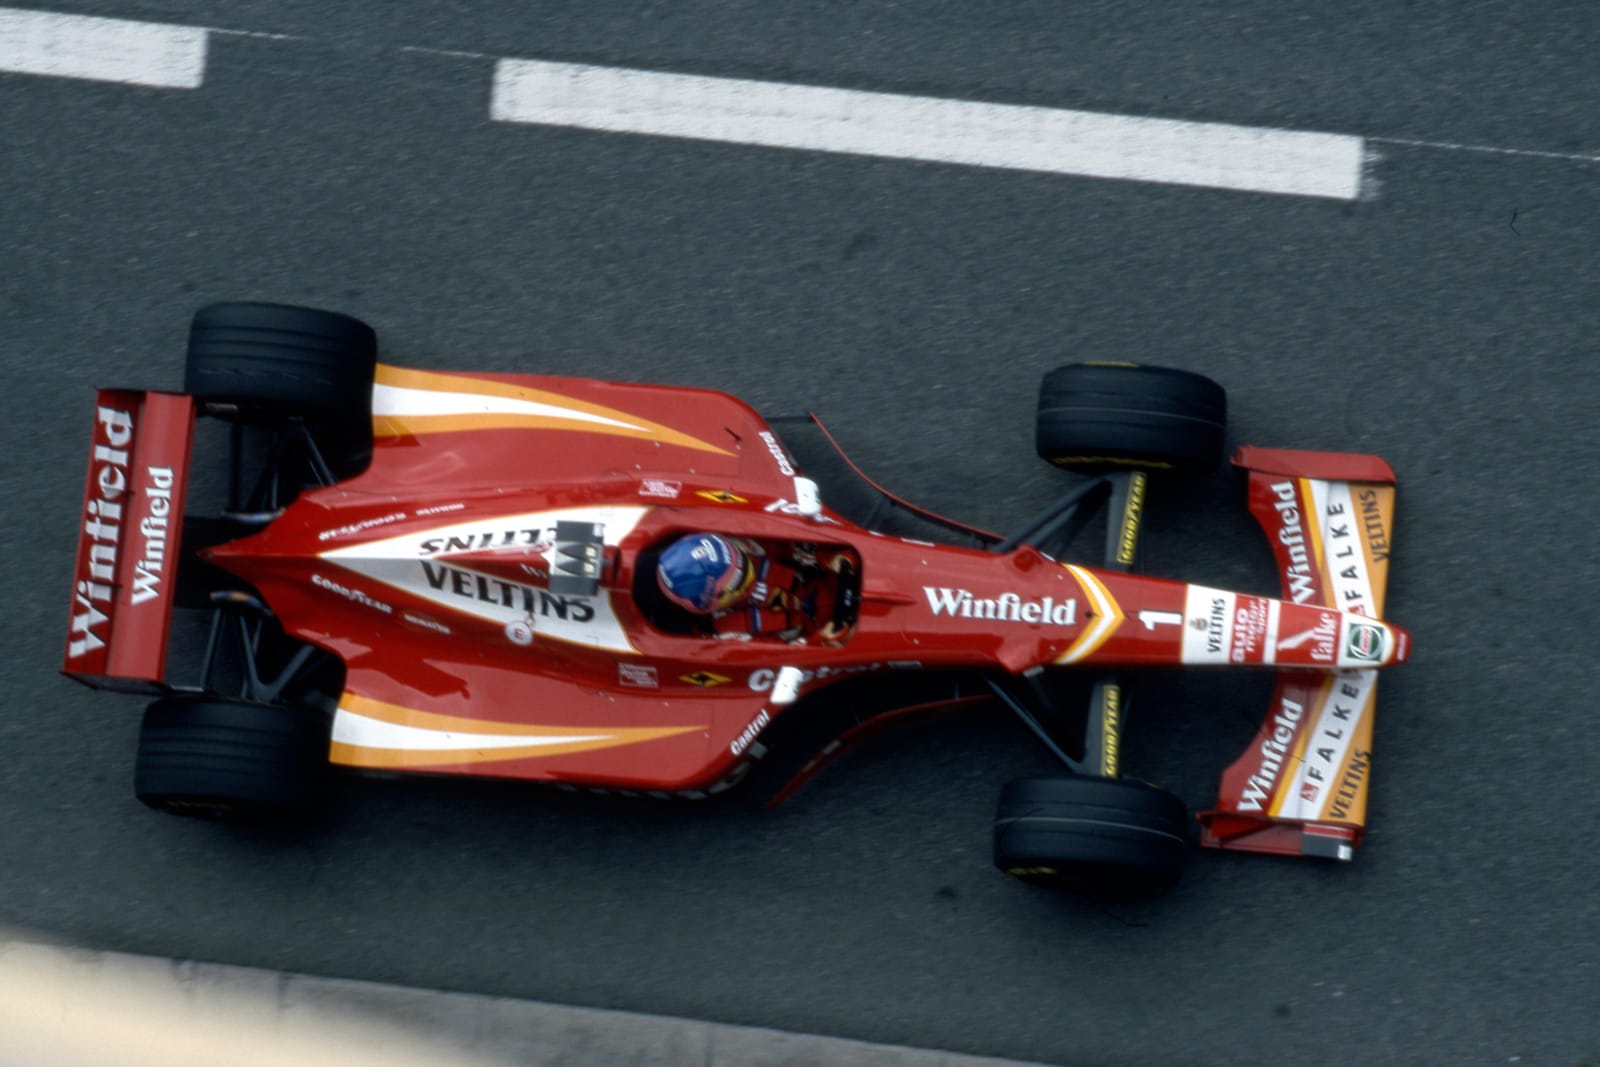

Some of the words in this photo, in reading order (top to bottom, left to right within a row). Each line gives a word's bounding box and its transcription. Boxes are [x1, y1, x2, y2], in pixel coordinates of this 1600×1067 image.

[68, 405, 134, 658] Winfield
[131, 466, 175, 606] Winfield
[418, 526, 558, 556] LTINS
[1271, 480, 1316, 604] Winfield
[1327, 502, 1363, 602] FALKE
[1359, 488, 1390, 564] VELTINS
[417, 559, 596, 623] VELTINS
[922, 585, 1077, 626] Winfield
[1138, 610, 1183, 630] 1
[1206, 597, 1226, 654] VELTINS
[730, 709, 770, 756] Castrol
[1236, 697, 1305, 811] Winfield
[1308, 683, 1360, 782] FALKE
[1328, 751, 1372, 820] VELTINS
